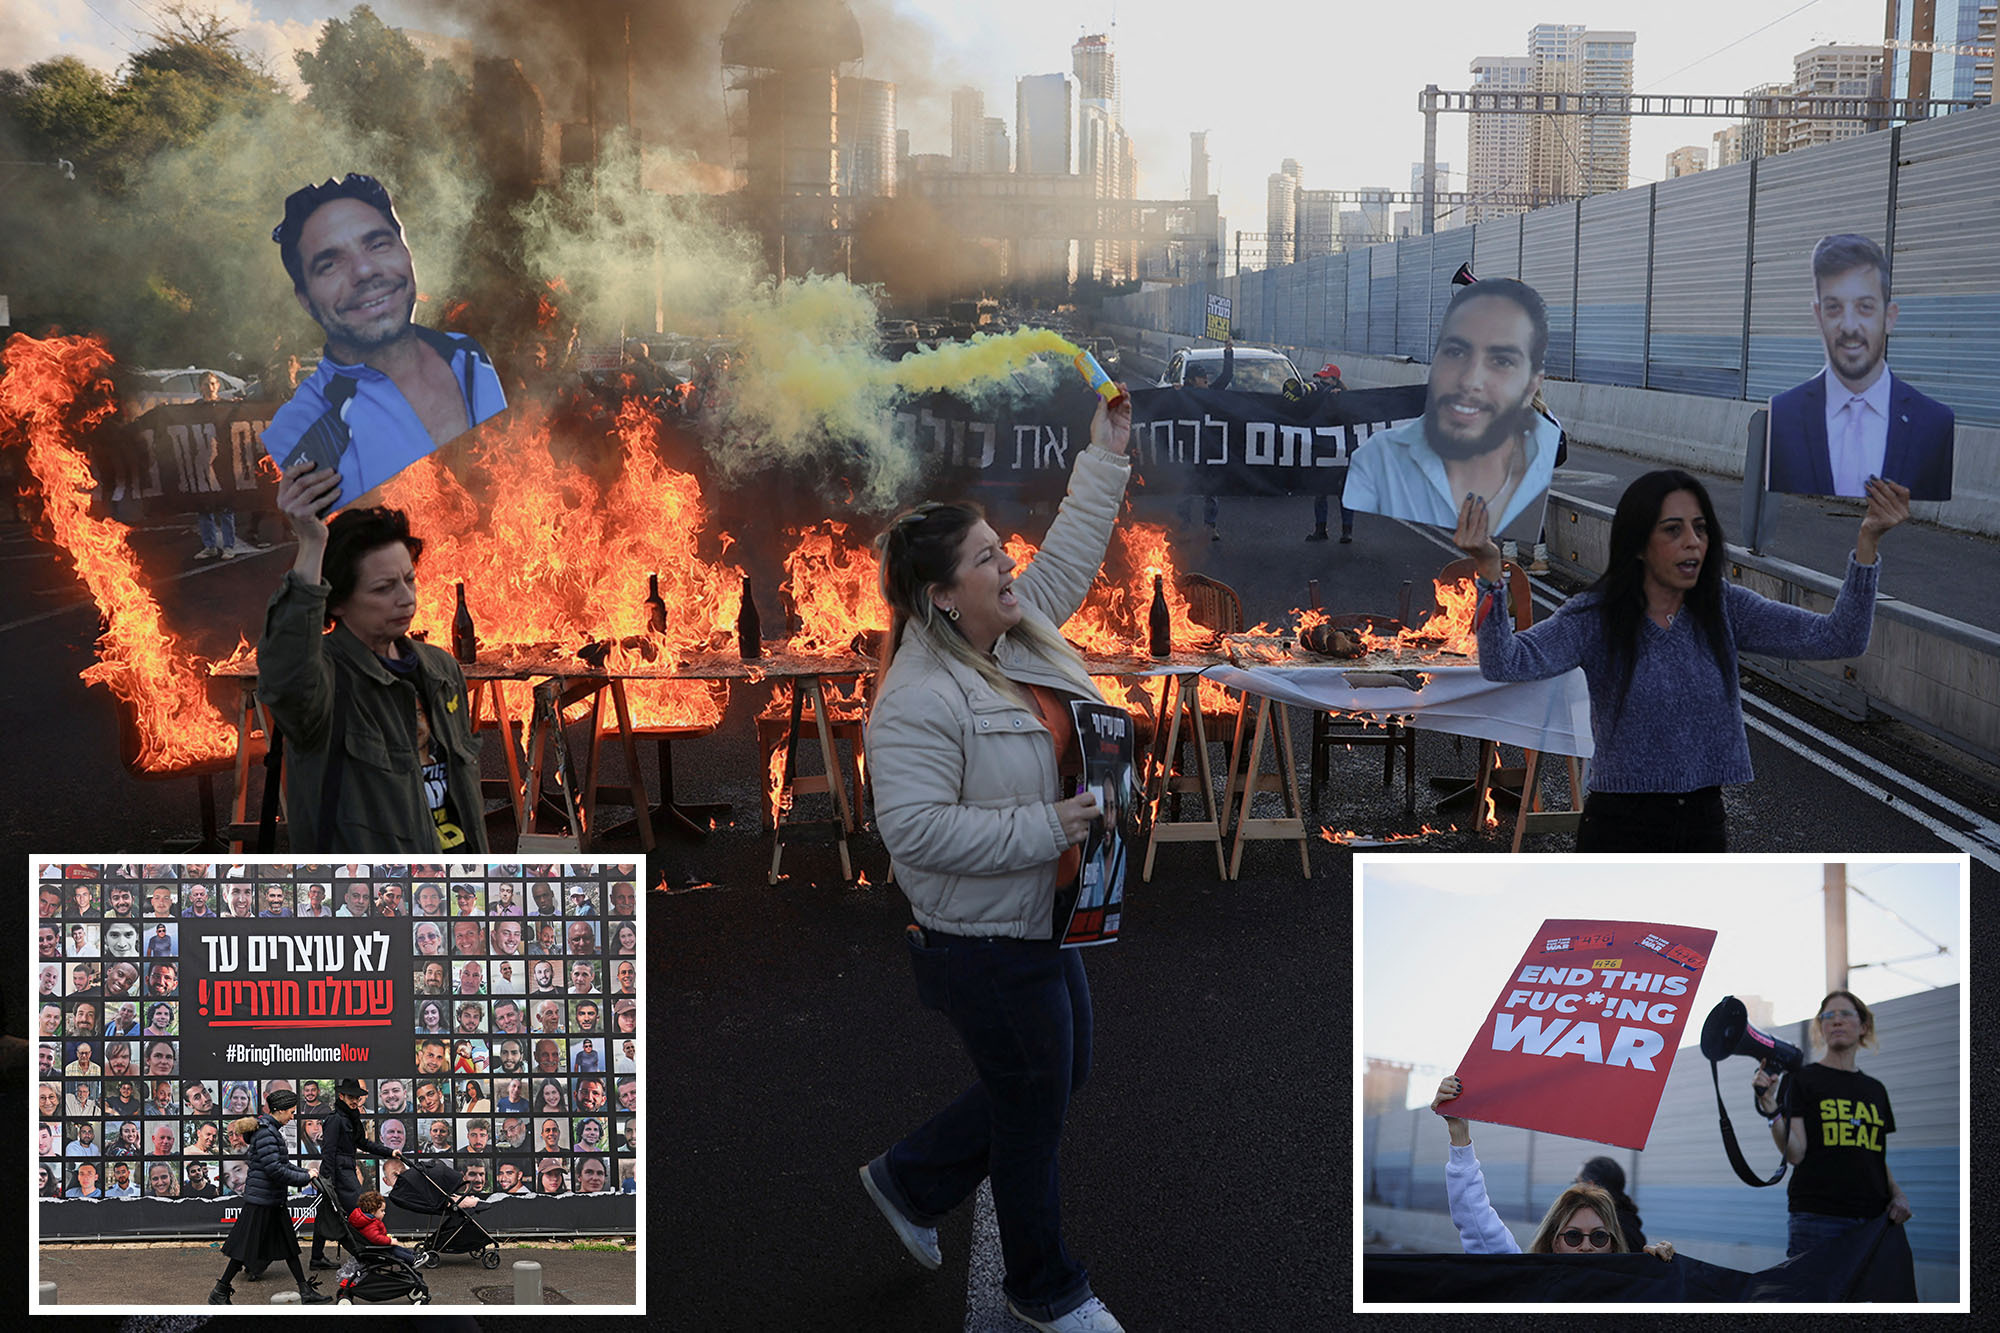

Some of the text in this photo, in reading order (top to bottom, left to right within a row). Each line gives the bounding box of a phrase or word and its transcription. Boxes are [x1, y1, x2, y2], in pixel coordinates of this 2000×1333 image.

[1012, 425, 1068, 469] את
[201, 931, 390, 973] לא עוצרים עד
[1595, 960, 1617, 968] 476
[1517, 964, 1689, 996] END THIS
[198, 976, 394, 1017] שכולם חוזרים!
[226, 1043, 370, 1066] #BringThemHomeNow
[1491, 1013, 1665, 1072] WAR
[1820, 1098, 1884, 1127] SEAL
[1822, 1121, 1882, 1152] DEAL
